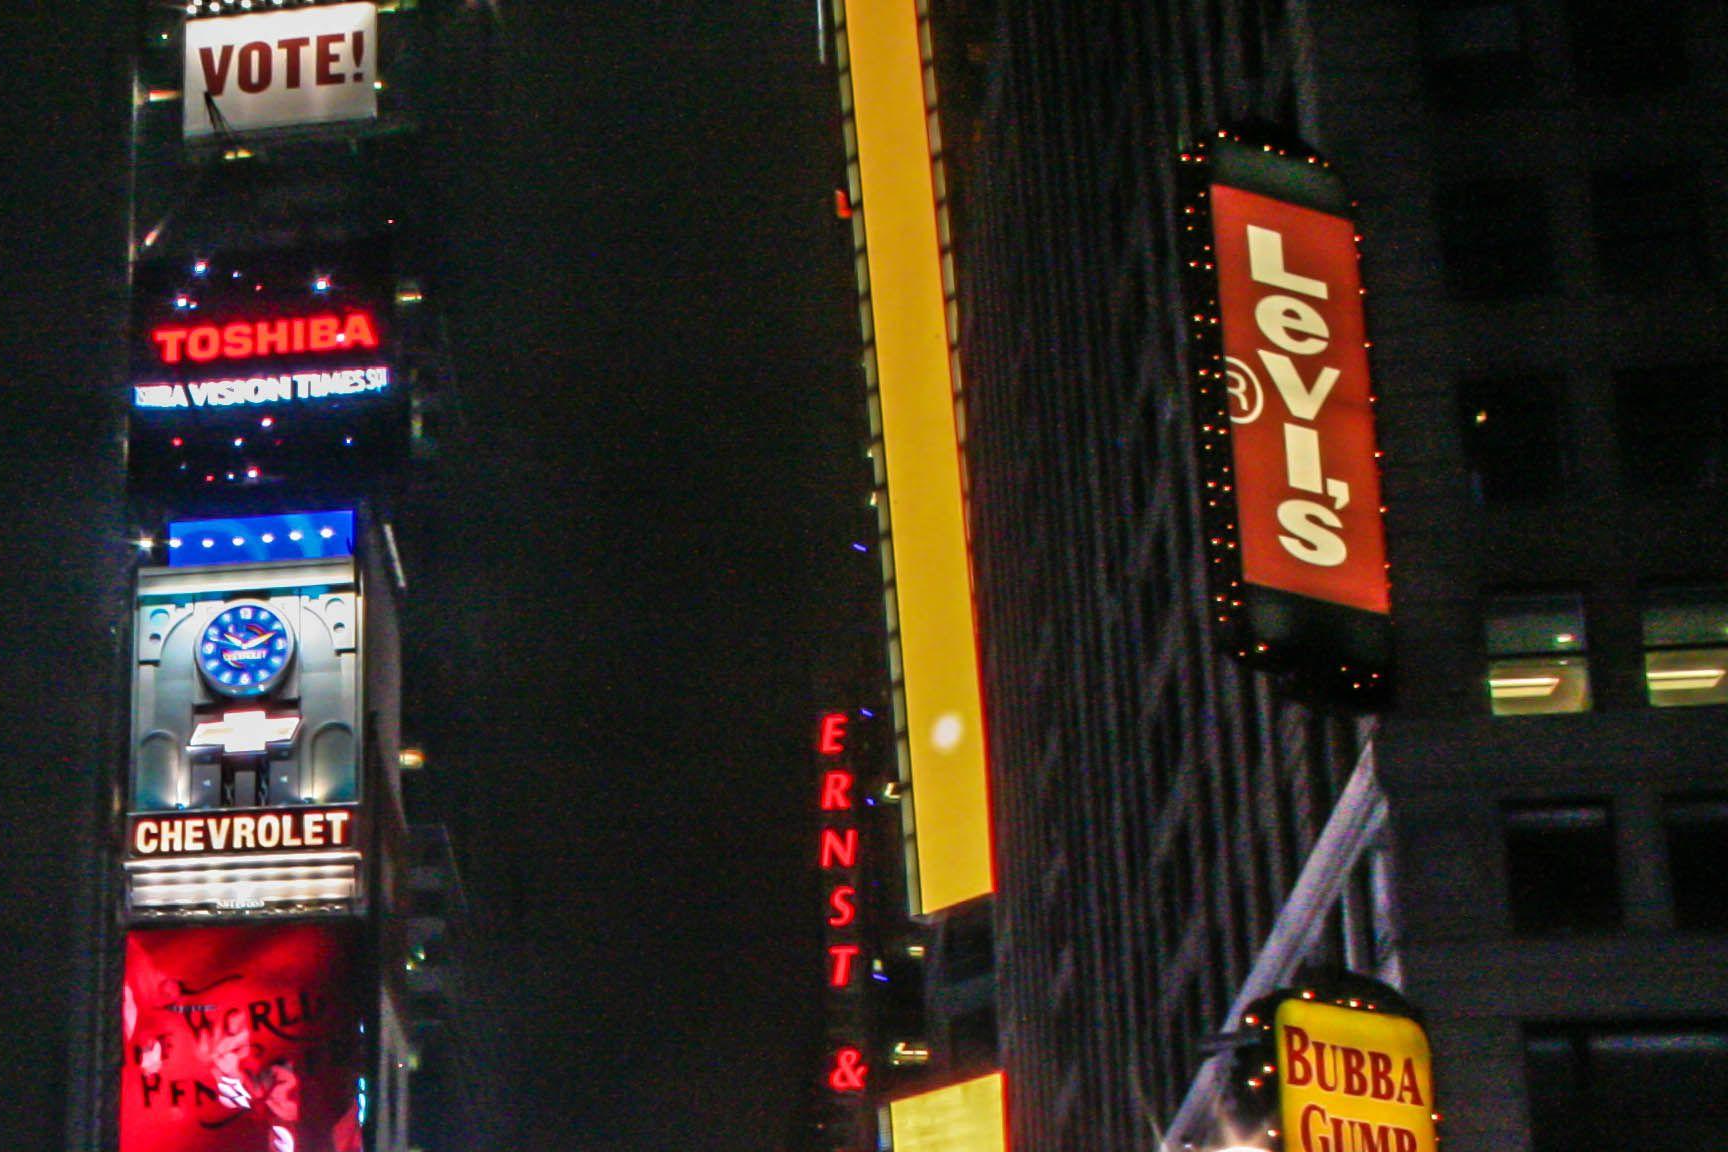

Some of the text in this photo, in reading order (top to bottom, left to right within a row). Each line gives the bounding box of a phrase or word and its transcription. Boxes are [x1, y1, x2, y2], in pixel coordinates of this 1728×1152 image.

[198, 30, 365, 98] VOTE!
[154, 312, 378, 363] TOSHIBA
[188, 376, 292, 407] VISION
[292, 369, 366, 398] TIMES
[135, 811, 349, 854] CHEVROLET
[818, 712, 861, 989] ERNST
[828, 1047, 869, 1091] &
[1282, 1024, 1425, 1108] BUBBA
